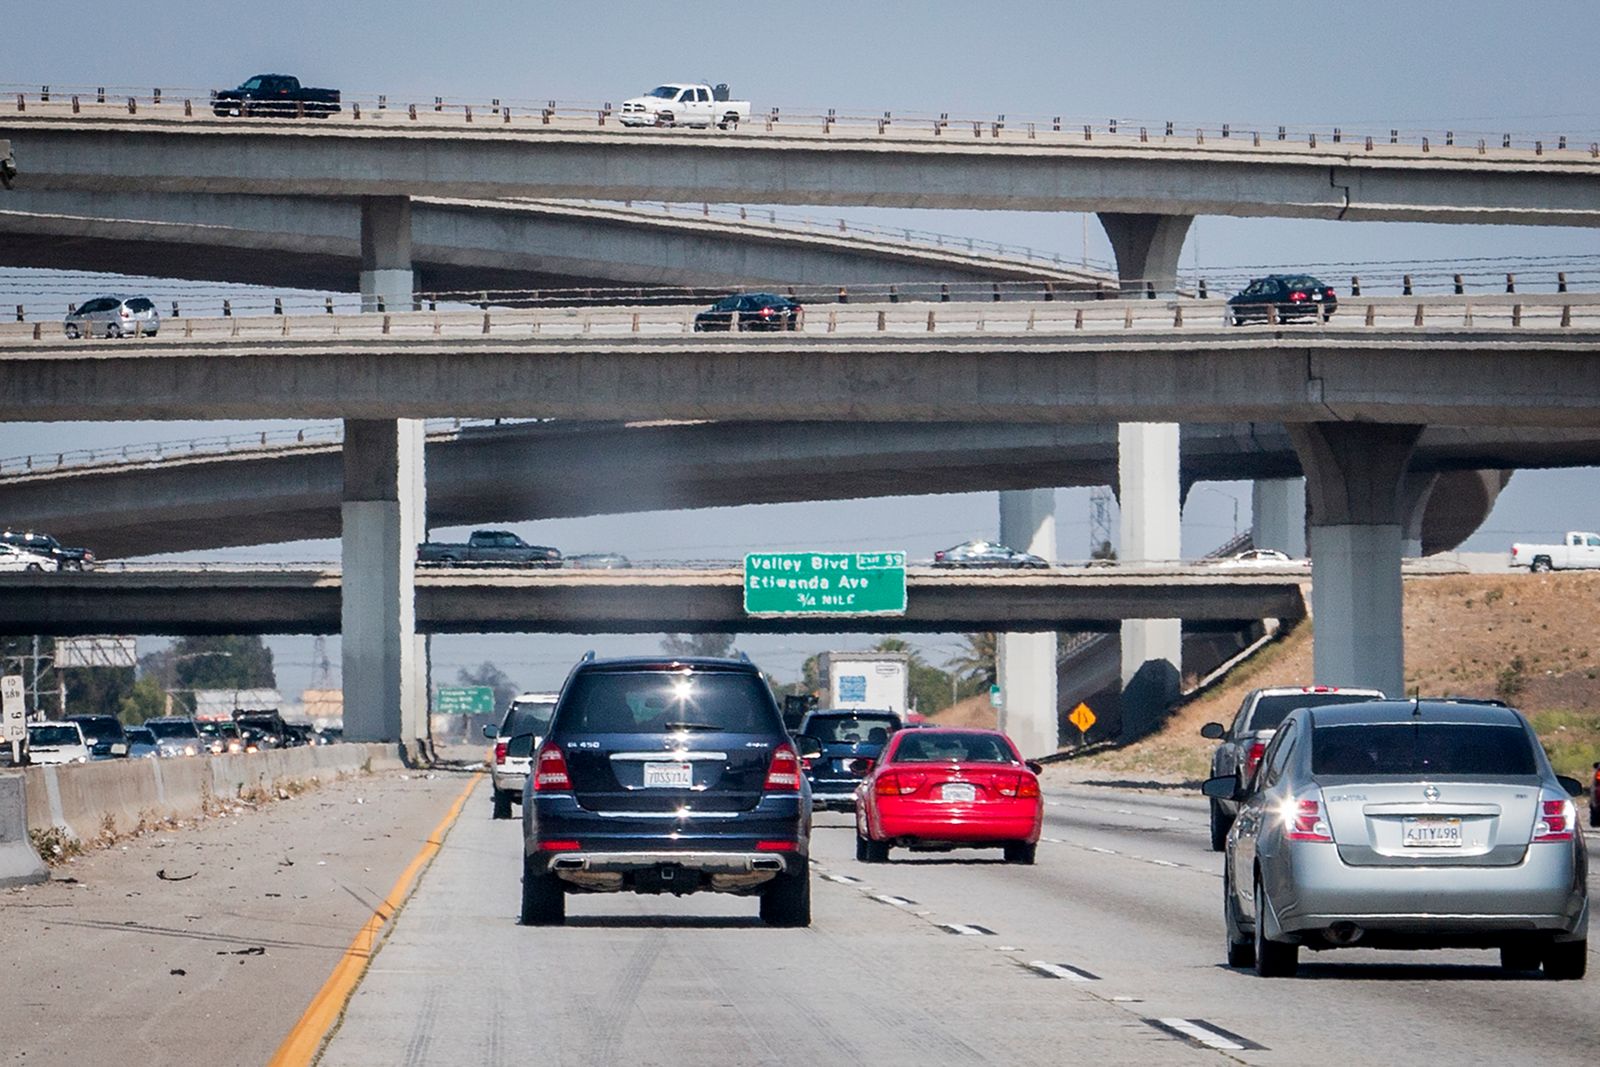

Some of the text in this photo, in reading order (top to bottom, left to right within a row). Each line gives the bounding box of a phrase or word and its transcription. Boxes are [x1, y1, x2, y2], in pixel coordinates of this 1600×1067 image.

[751, 556, 849, 572] Valley Blvd
[749, 575, 869, 590] Etiwanda Ave
[822, 594, 856, 605] MILE
